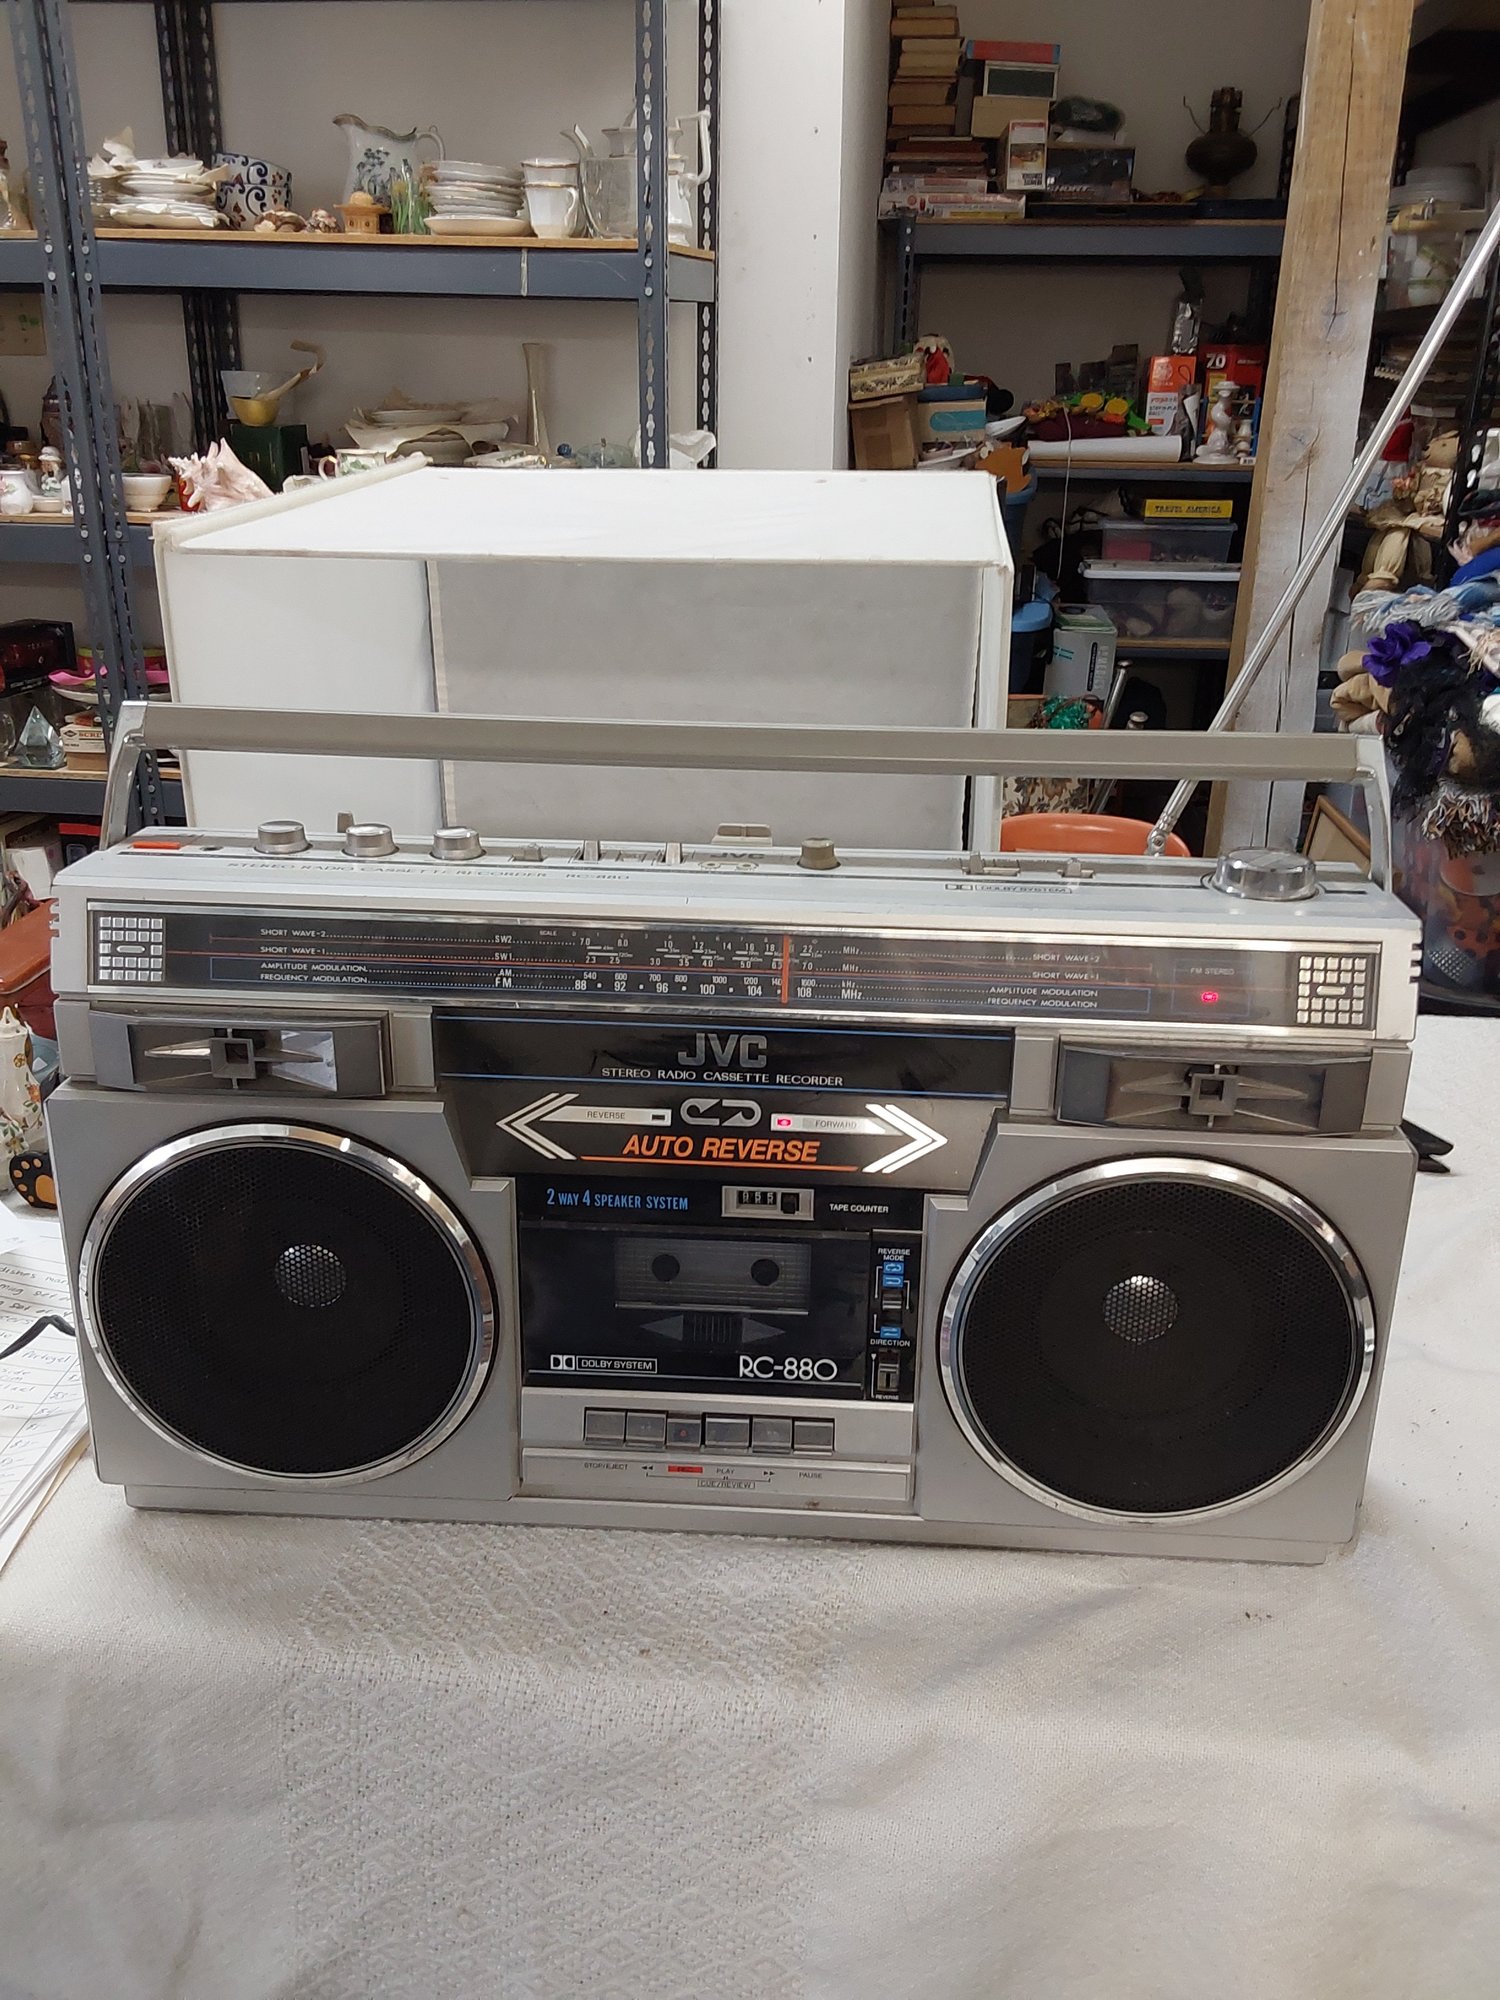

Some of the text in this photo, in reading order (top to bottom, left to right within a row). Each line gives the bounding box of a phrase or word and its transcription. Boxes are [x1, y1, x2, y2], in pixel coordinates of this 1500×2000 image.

[1206, 353, 1227, 369] 70
[1155, 505, 1222, 514] TRAVEL AMERICA
[710, 852, 765, 860] JVC
[260, 928, 288, 937] SHORT
[291, 930, 327, 938] WAVE-2
[495, 935, 513, 944] SW2
[664, 940, 674, 950] 10
[694, 941, 705, 951] 12
[722, 942, 732, 951] 14
[765, 943, 776, 952] 18
[802, 945, 813, 953] 22
[842, 946, 860, 955] MHz
[1032, 953, 1061, 962] SHORT
[1064, 954, 1100, 963] WAVE-2
[260, 946, 288, 954] SHORT
[291, 947, 327, 955] WAVE-1
[494, 952, 513, 961] SW1
[842, 964, 860, 973] MHz
[1032, 971, 1061, 980] SHORT
[1064, 972, 1100, 981] WAVE-1
[1204, 967, 1235, 977] STEREO
[260, 962, 309, 971] AMPLITUDE
[311, 964, 367, 973] MODULATION
[499, 968, 513, 977] AM
[583, 971, 597, 980] 540
[614, 972, 628, 981] 600
[649, 973, 662, 982] 700
[674, 974, 688, 983] 800
[712, 975, 728, 984] 1000
[743, 976, 759, 985] 1200
[771, 977, 783, 986] 140
[841, 979, 856, 989] kHz
[988, 986, 1039, 996] AMPLITUDE
[1040, 988, 1099, 997] MODULATION
[260, 973, 1098, 1009] FREQUENCY MODULATION FM 88 92 96 100 104 108 MHz FREQUENCY MODULATION
[677, 1032, 768, 1069] JVC
[601, 1067, 844, 1087] STEREO RADIO CASSETTE RECORDER
[586, 1110, 626, 1120] REVERSE
[815, 1119, 858, 1130] FORWARD
[622, 1133, 821, 1163] AUTO REVERSE
[546, 1188, 689, 1211] 2 WAY 4 SPEAKER SYSTEM
[829, 1203, 889, 1214] TAPE COUNTER
[878, 1247, 911, 1256] REVERSE
[883, 1254, 905, 1262] MODE
[870, 1338, 911, 1348] DIRECTION
[581, 1358, 653, 1371] DOLBY SYSTEM
[739, 1355, 838, 1381] RC-880
[875, 1393, 899, 1401] REVERSE
[584, 1462, 628, 1472] STOP/EJECT
[716, 1467, 735, 1476] PLAY
[799, 1471, 822, 1480] PAUSE
[700, 1480, 752, 1490] CUE/REVIEW
